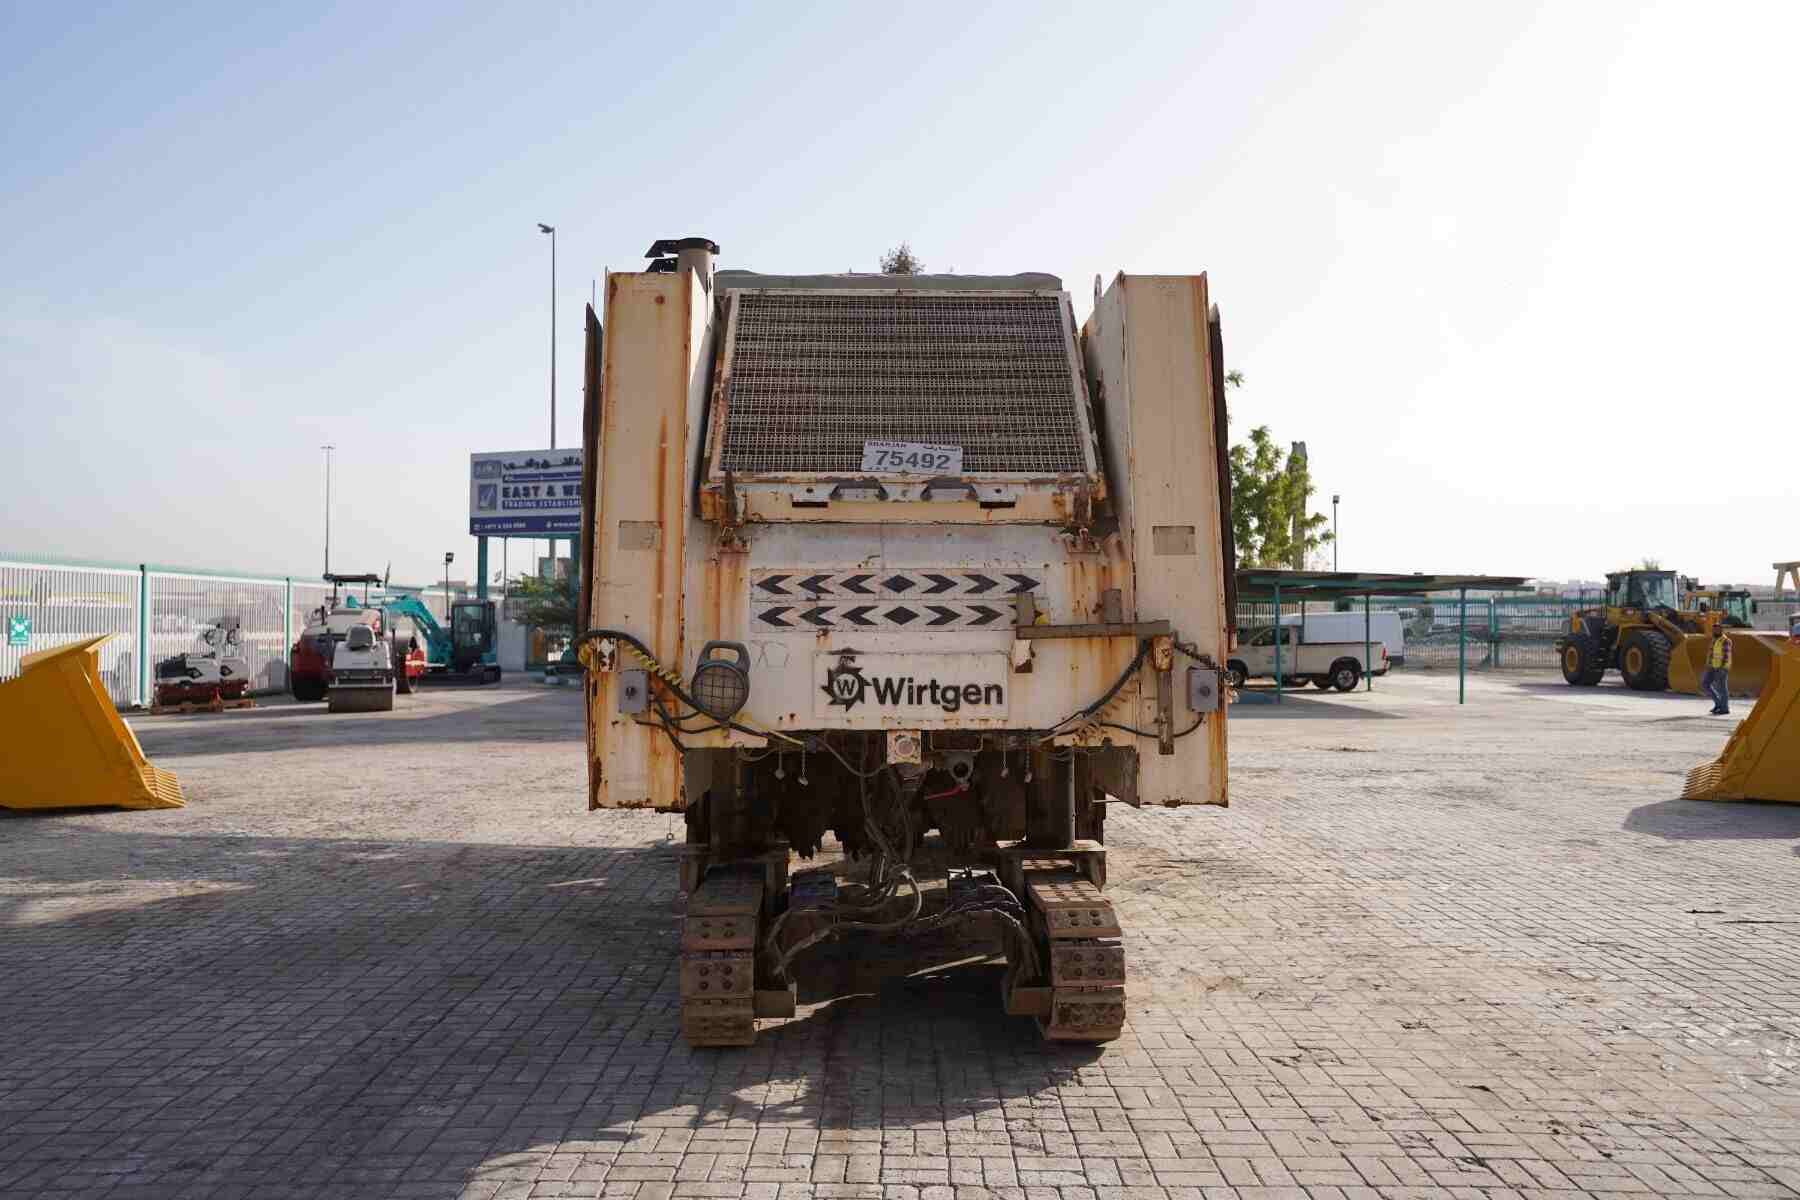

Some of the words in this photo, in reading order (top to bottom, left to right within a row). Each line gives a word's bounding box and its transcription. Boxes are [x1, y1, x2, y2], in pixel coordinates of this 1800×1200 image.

[875, 450, 951, 470] 75492
[836, 679, 856, 696] W
[872, 677, 1003, 712] Wirtgen
